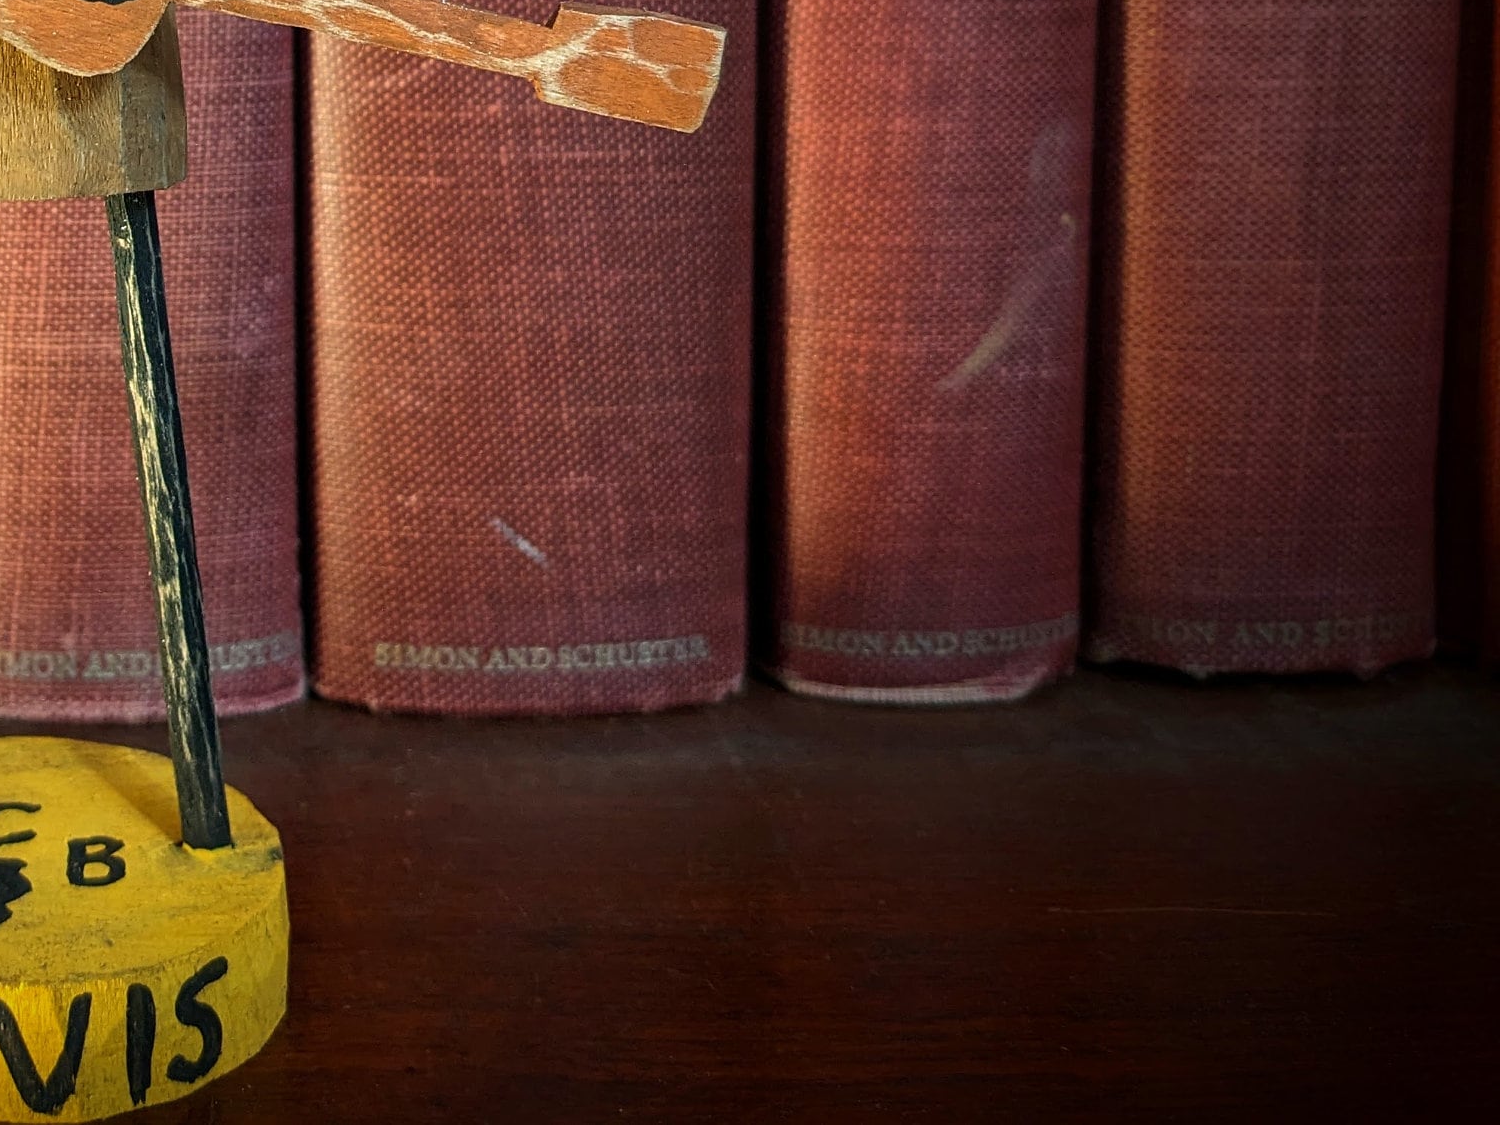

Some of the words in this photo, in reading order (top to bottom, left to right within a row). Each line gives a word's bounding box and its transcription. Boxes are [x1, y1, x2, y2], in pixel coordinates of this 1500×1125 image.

[374, 642, 480, 670] SIMON
[482, 645, 554, 672] AND
[891, 629, 958, 658] AND
[82, 649, 150, 679] AND
